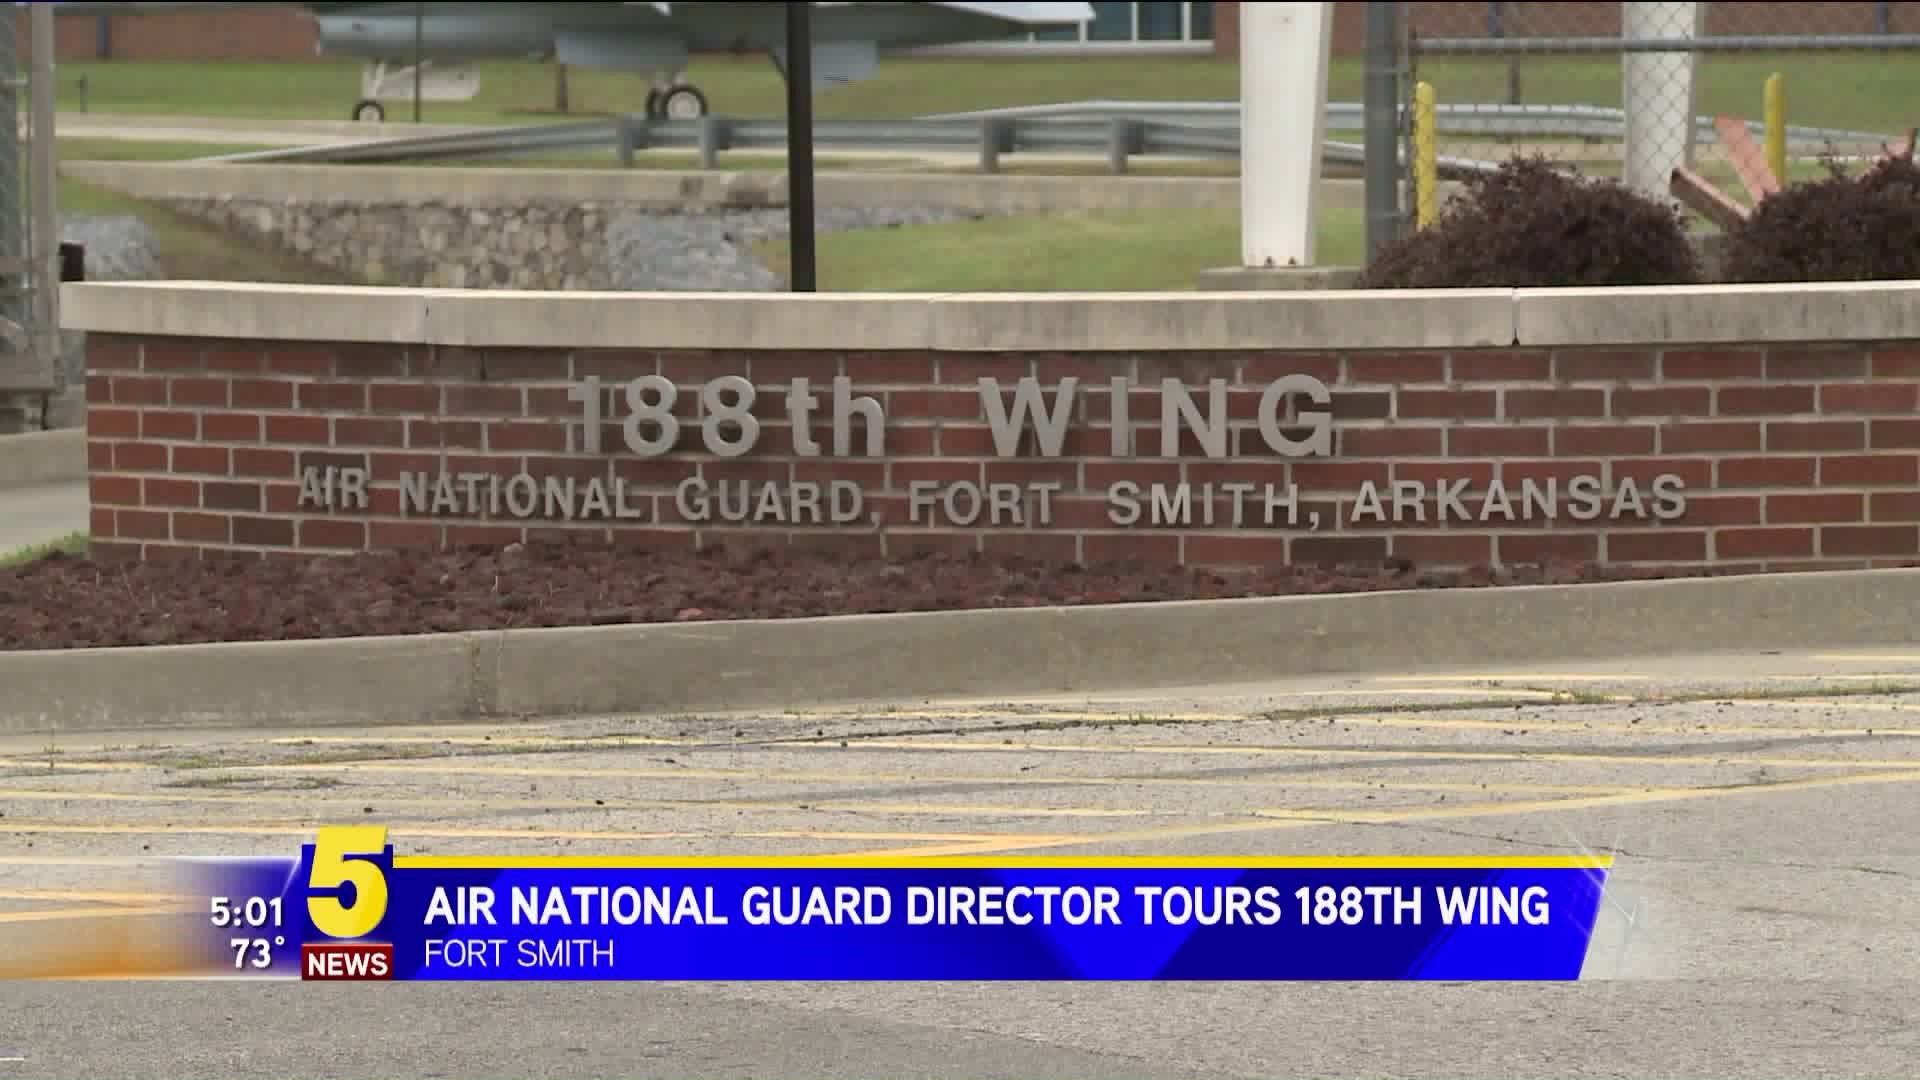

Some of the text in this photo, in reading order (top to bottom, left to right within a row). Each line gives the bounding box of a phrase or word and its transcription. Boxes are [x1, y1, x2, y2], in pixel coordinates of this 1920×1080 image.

[567, 374, 1332, 458] 188th WING
[298, 465, 1687, 532] AIR NATIONAL GUARD, FORT SMITH, ARKANSAS
